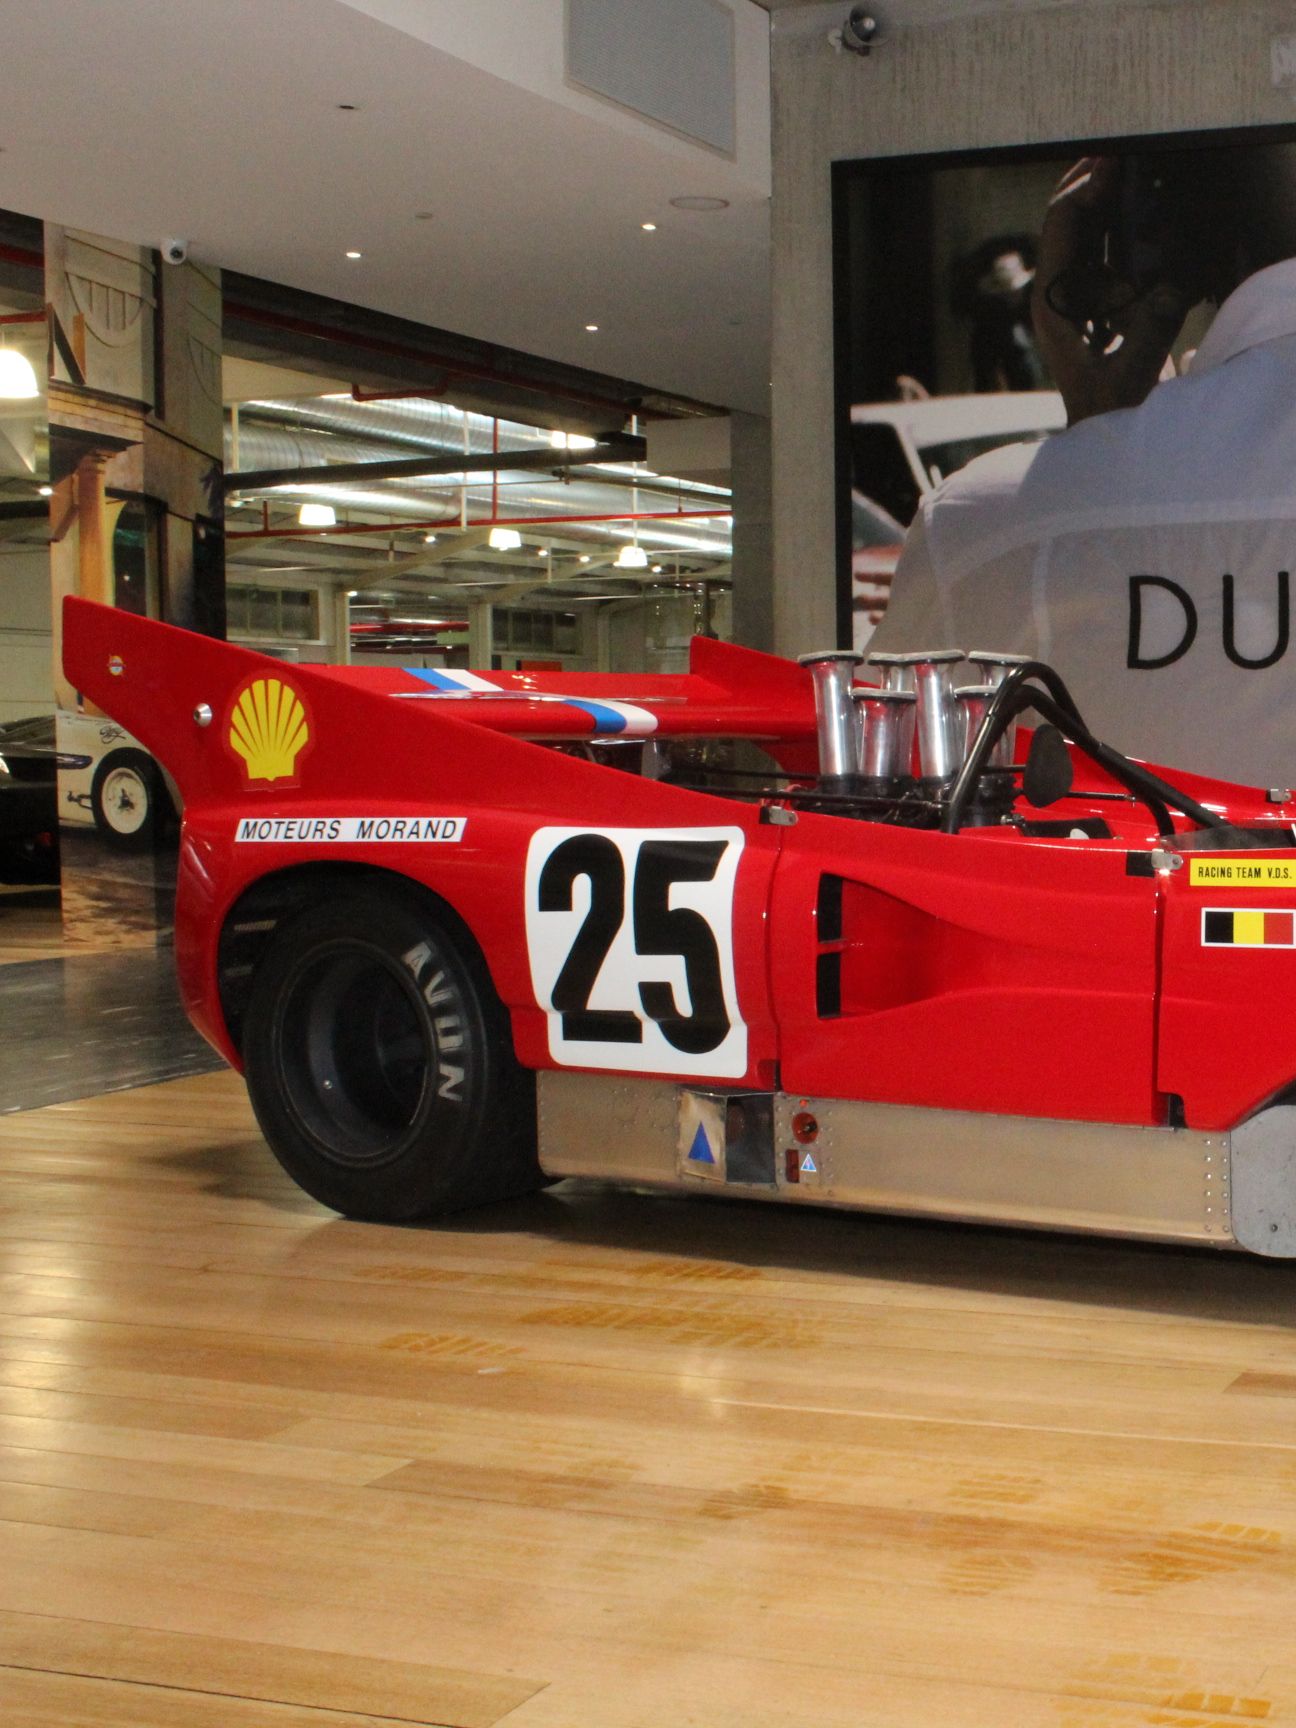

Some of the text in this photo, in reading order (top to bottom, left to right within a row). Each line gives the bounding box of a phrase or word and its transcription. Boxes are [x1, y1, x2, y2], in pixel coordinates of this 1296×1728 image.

[241, 820, 457, 840] MOTEURS MORAND
[1198, 866, 1293, 880] RACING TEAM V.D.S.
[538, 833, 732, 1055] 25
[402, 941, 465, 1102] AVON
